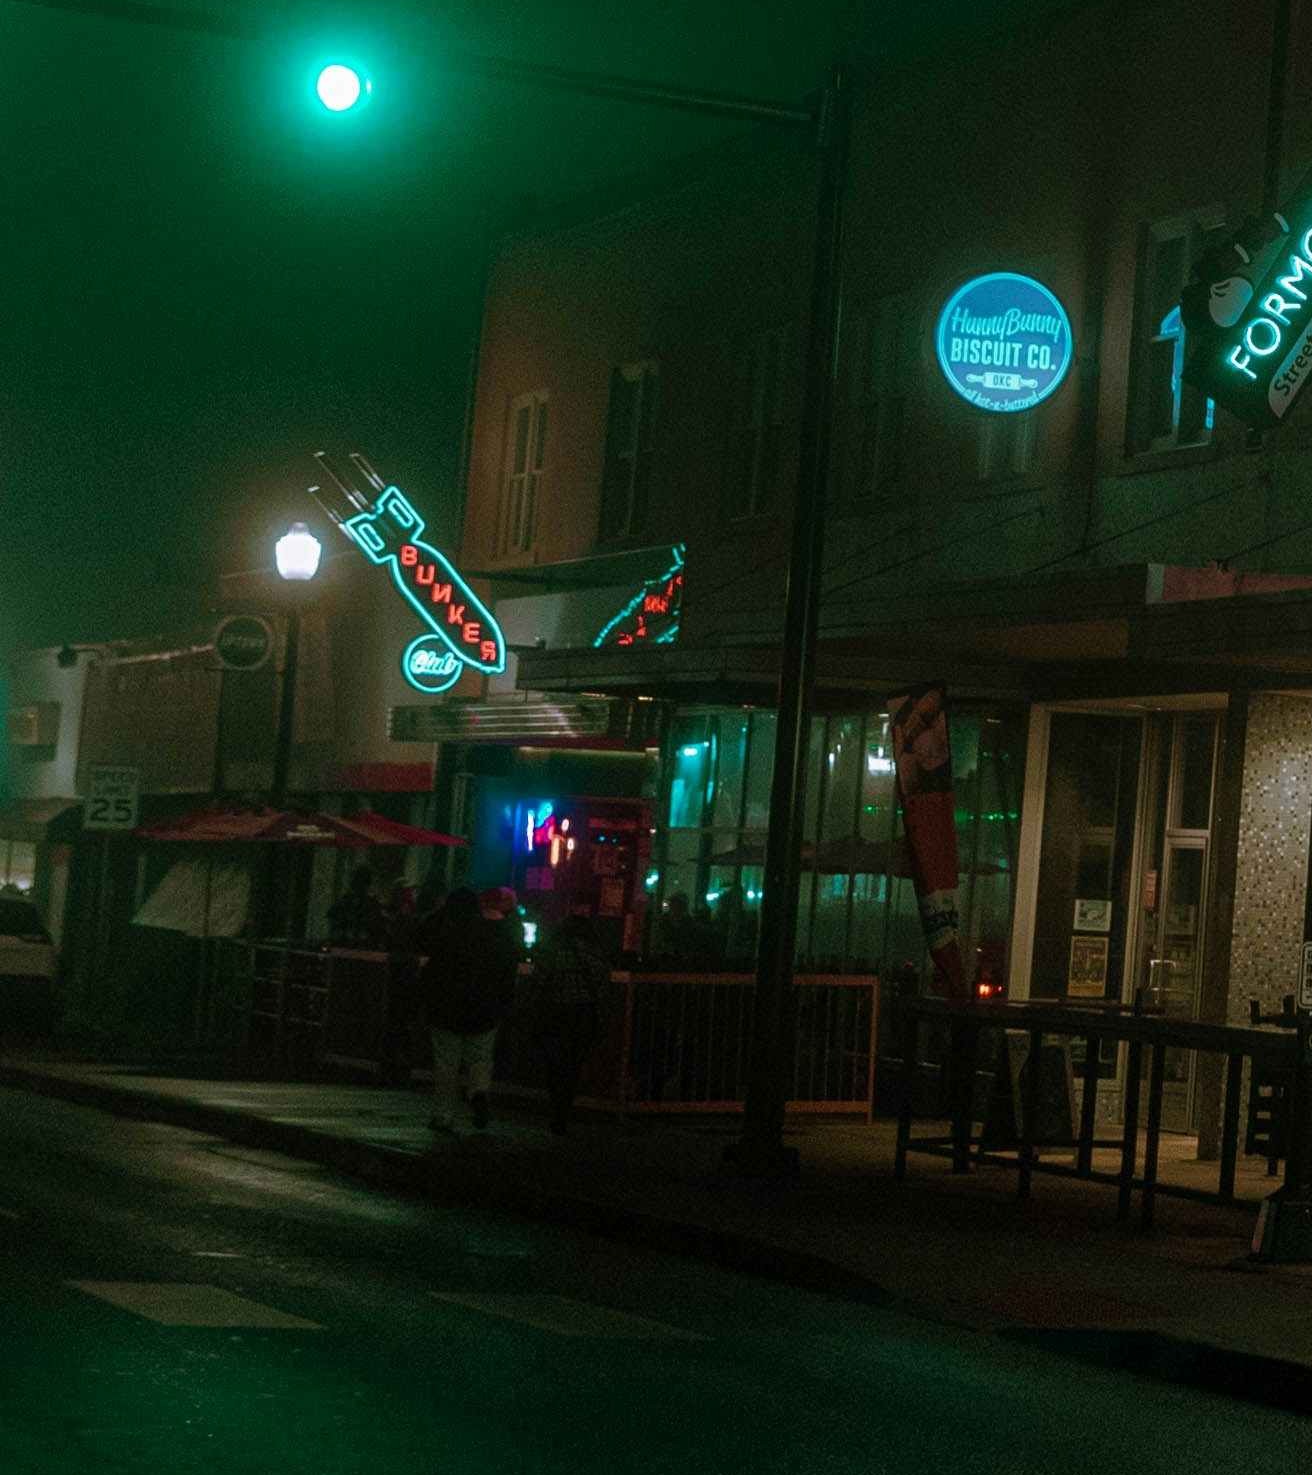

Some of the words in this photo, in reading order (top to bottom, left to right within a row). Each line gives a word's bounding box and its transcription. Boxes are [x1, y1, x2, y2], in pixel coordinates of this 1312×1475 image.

[951, 337, 1023, 367] BISCUIT
[1026, 344, 1057, 371] CO.
[992, 374, 1012, 387] OKC
[89, 798, 132, 822] 25
